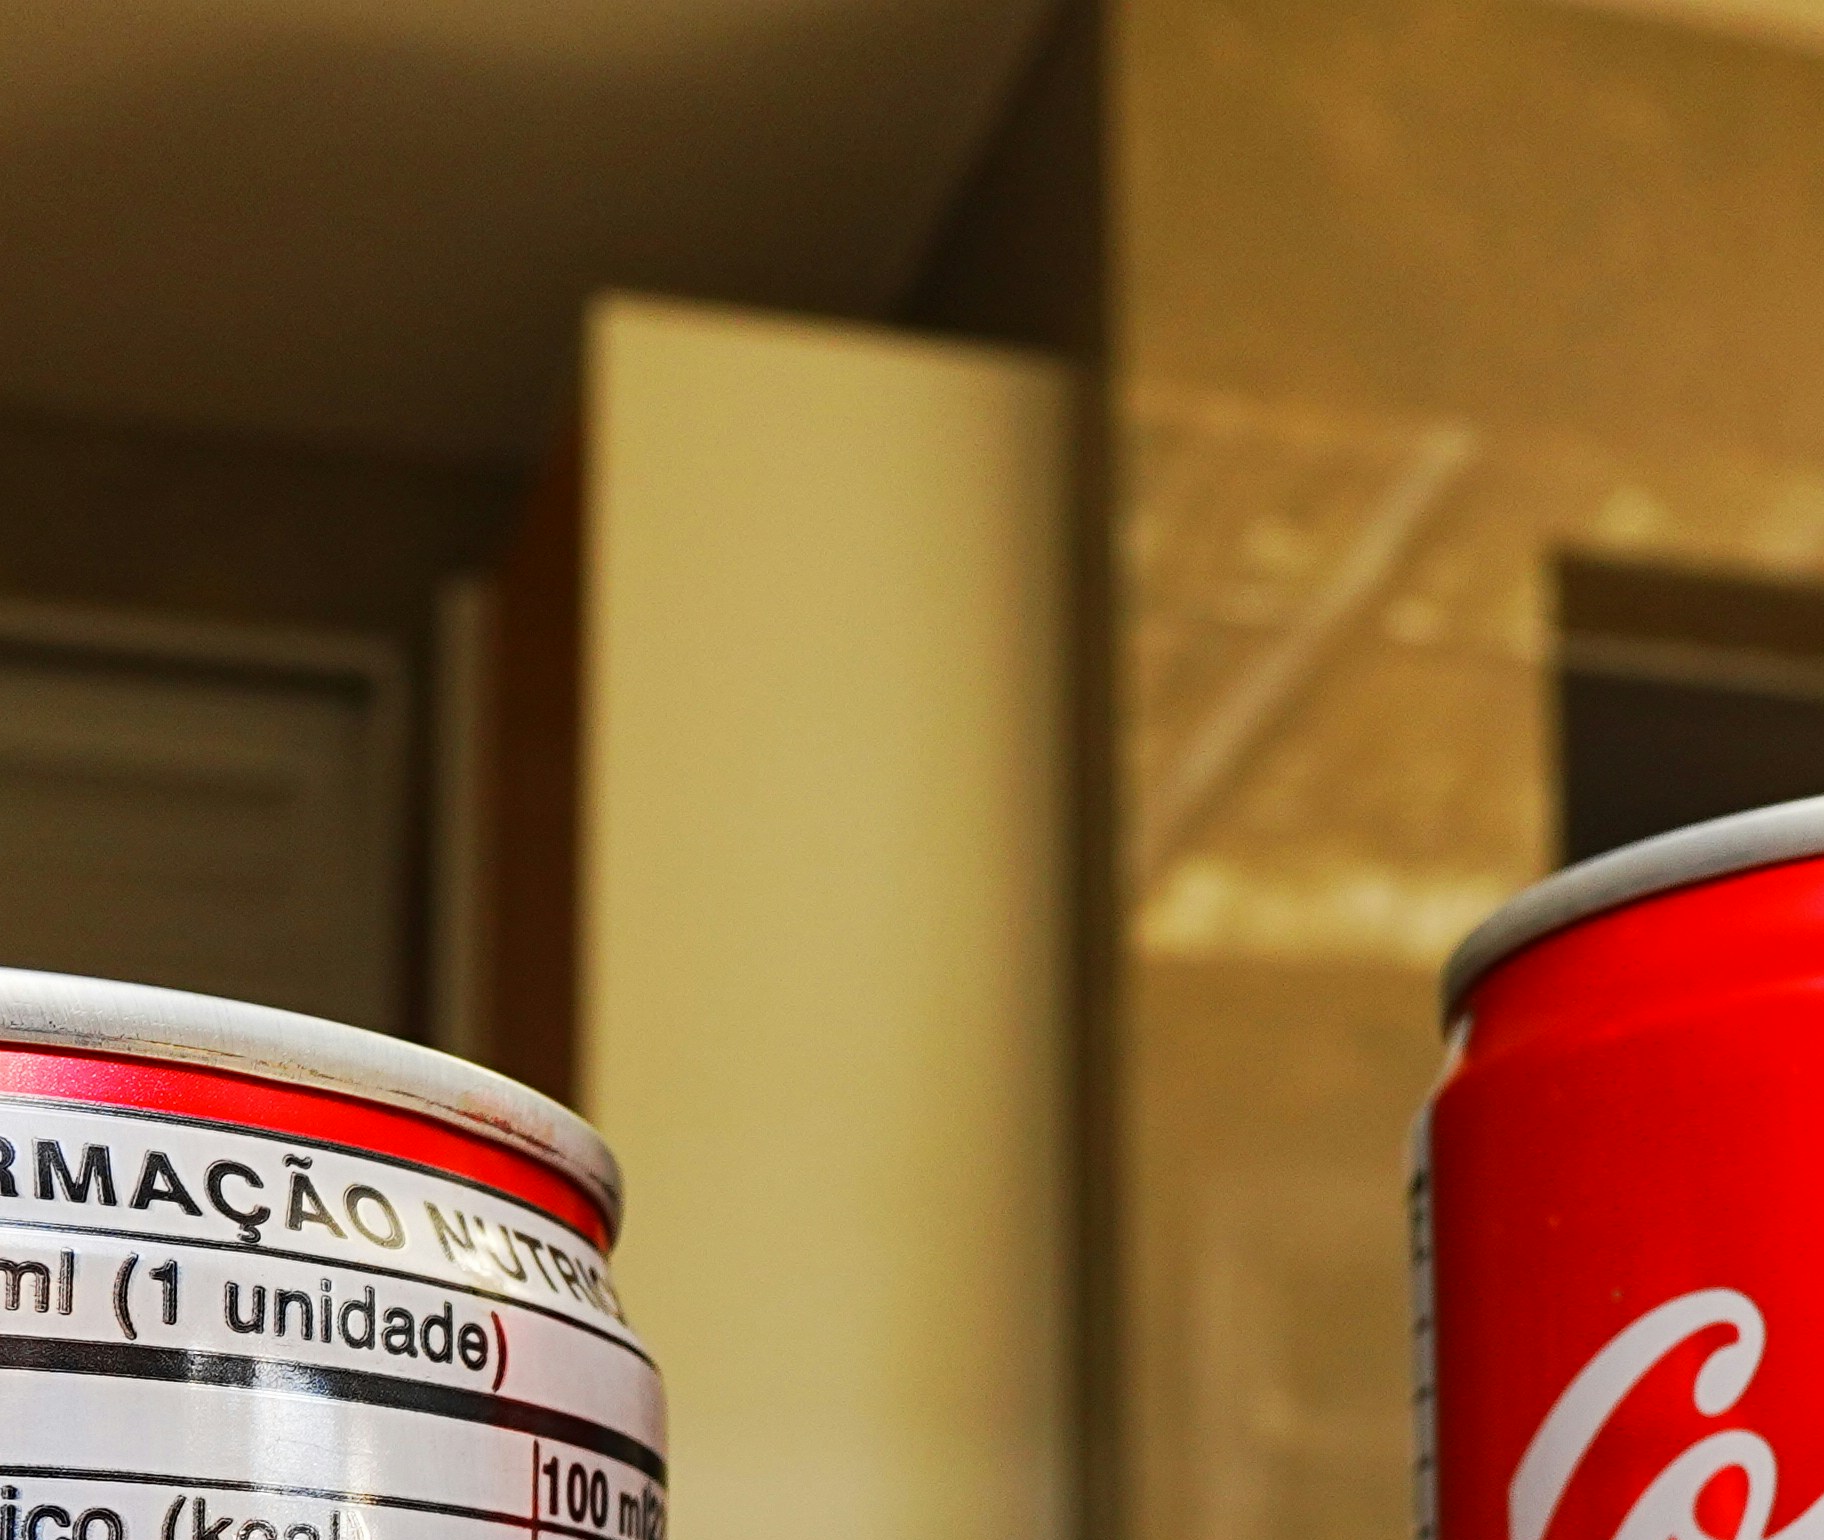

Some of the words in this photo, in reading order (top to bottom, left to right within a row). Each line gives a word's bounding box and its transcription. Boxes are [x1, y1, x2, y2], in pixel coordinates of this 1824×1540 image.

[113, 1251, 178, 1340] (1
[224, 1278, 508, 1392] unidade)
[542, 1455, 609, 1529] 100
